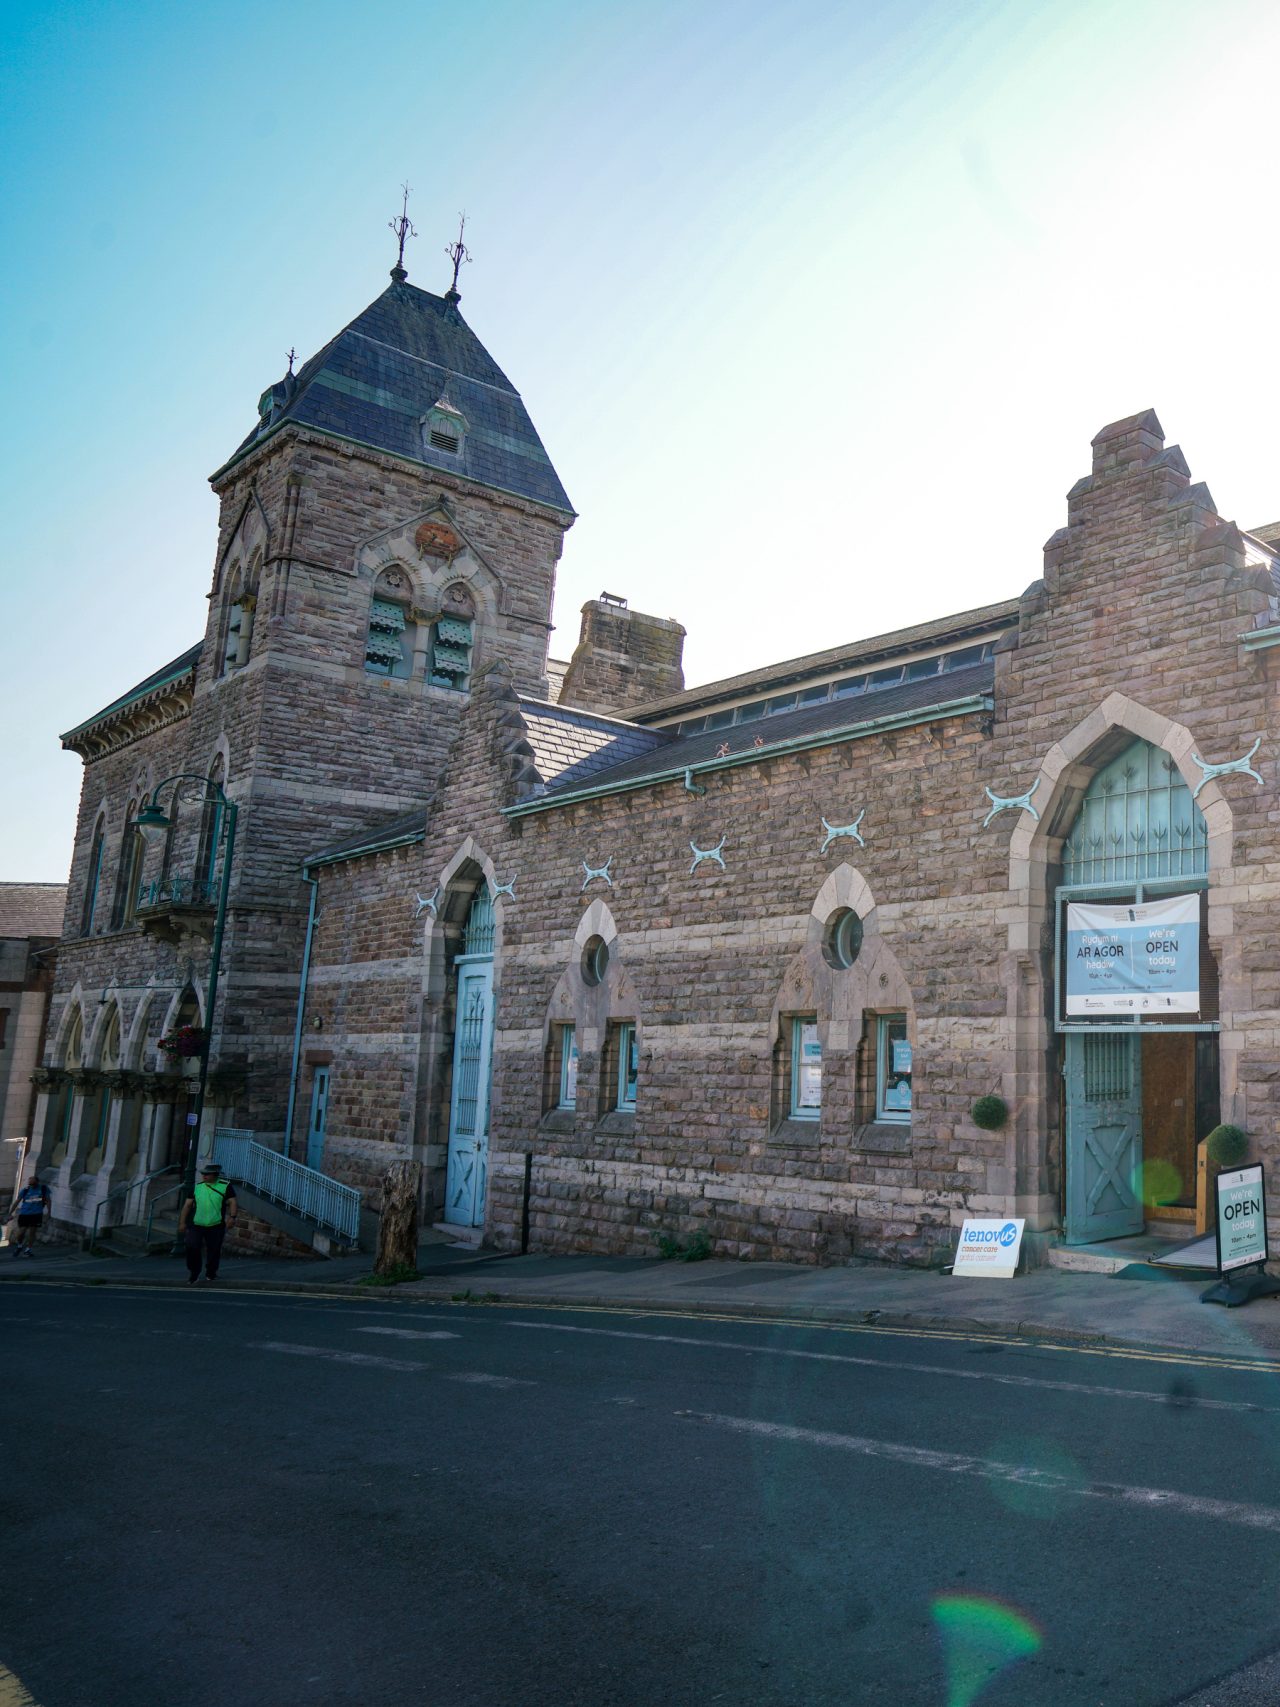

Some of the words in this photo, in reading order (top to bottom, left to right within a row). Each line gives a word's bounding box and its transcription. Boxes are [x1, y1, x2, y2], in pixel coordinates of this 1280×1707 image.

[1149, 928, 1176, 938] We're
[1082, 935, 1109, 945] Rydym
[1077, 947, 1091, 958] AR
[1094, 945, 1124, 958] AGOR
[1146, 941, 1179, 953] OPEN
[1087, 960, 1115, 969] heddiw
[1149, 955, 1176, 967] today
[1230, 1189, 1253, 1201] We're
[1224, 1198, 1260, 1221] OPEN
[1232, 1219, 1255, 1232] today
[964, 1227, 1016, 1242] tenovus
